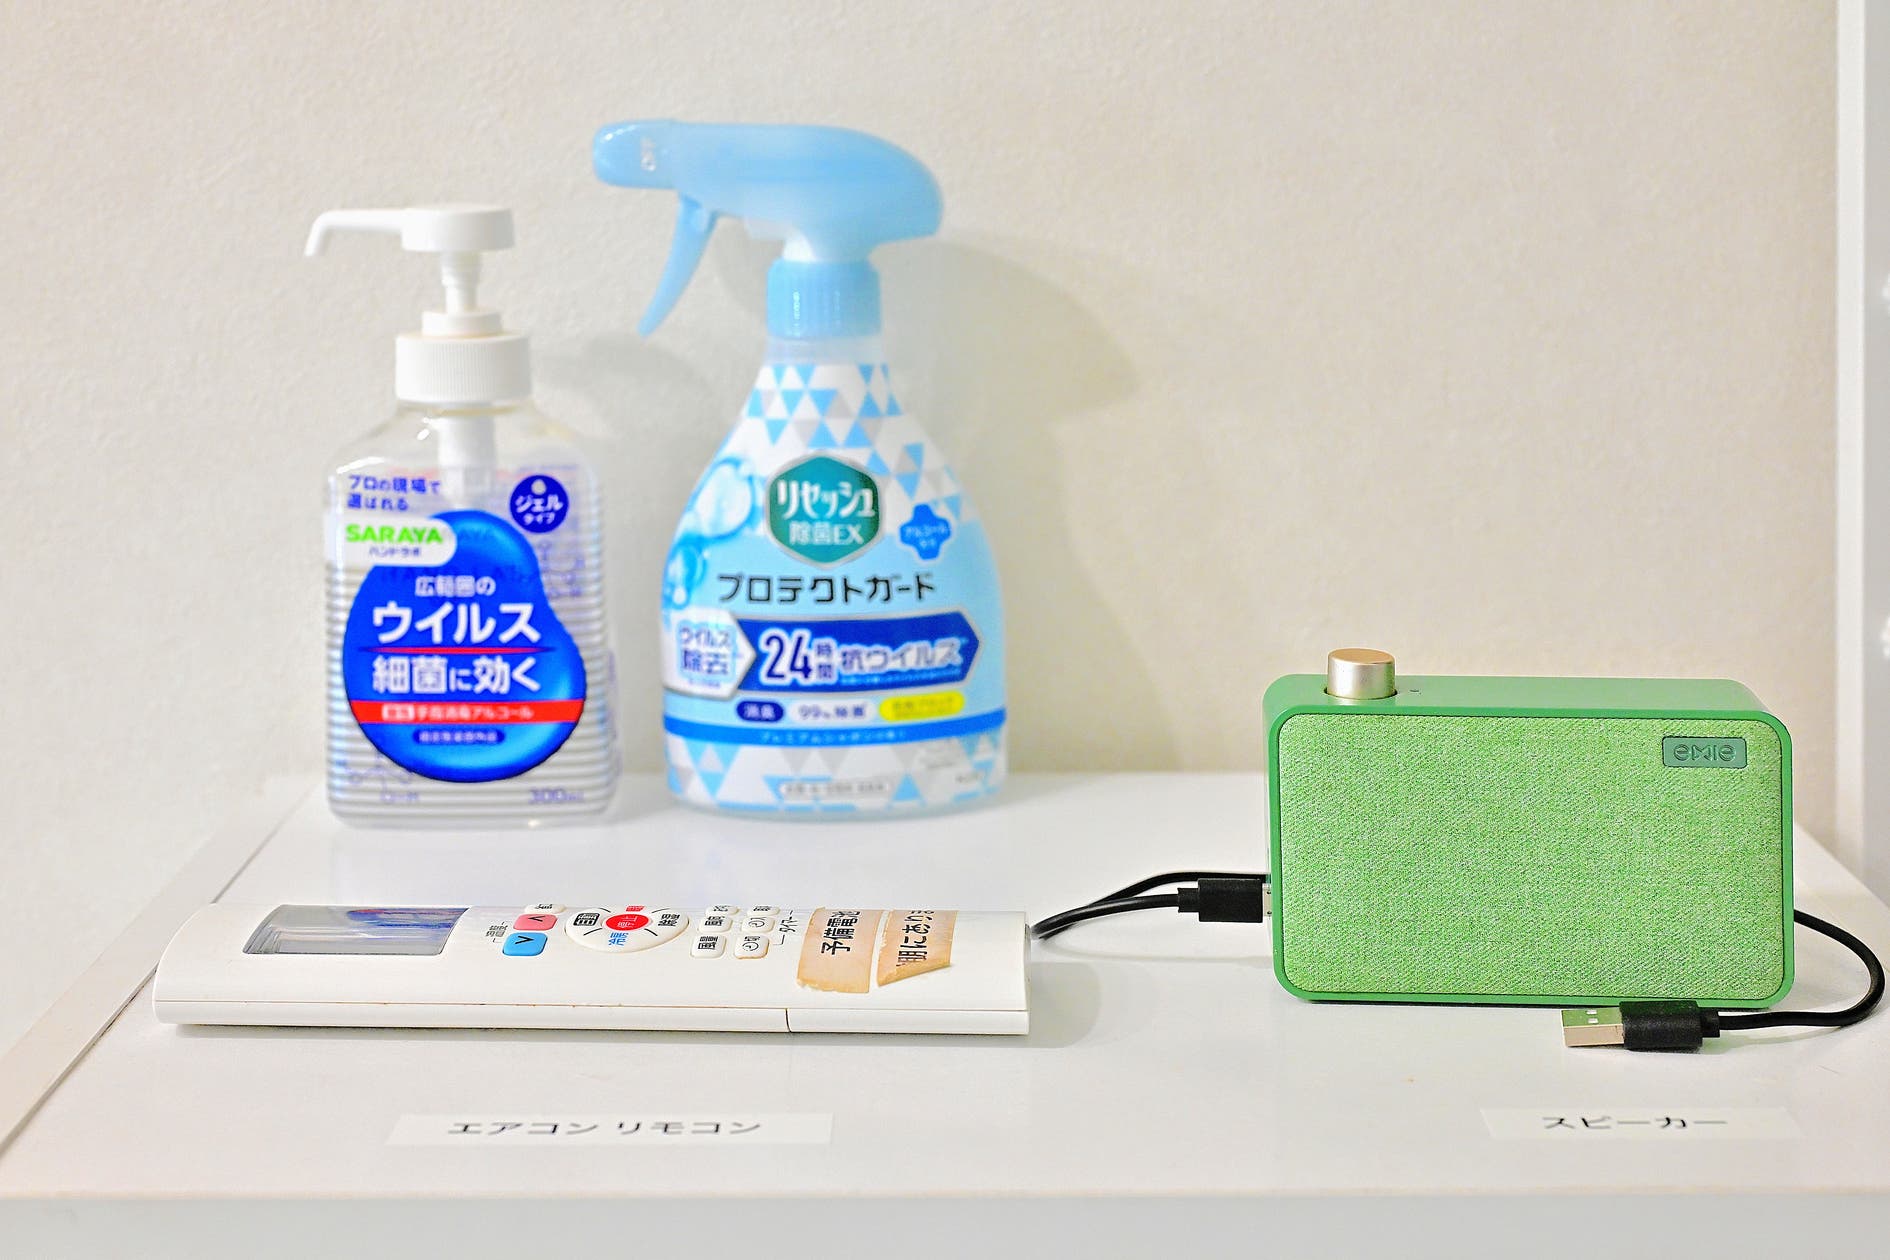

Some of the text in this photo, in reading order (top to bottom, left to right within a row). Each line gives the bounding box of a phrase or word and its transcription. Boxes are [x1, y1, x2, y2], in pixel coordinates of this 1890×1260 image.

[514, 494, 564, 514] ジェル
[777, 480, 876, 520] リセッシュ
[345, 523, 443, 545] SARAYA
[789, 521, 864, 546] 除菌EX
[414, 575, 497, 598] 広範囲の
[718, 572, 936, 603] プロテクトガード
[373, 601, 541, 645] ウイルス
[372, 655, 541, 695] 細菌に効く
[447, 1121, 761, 1136] エアコン リモコン
[1542, 1115, 1728, 1130] スピーカー
